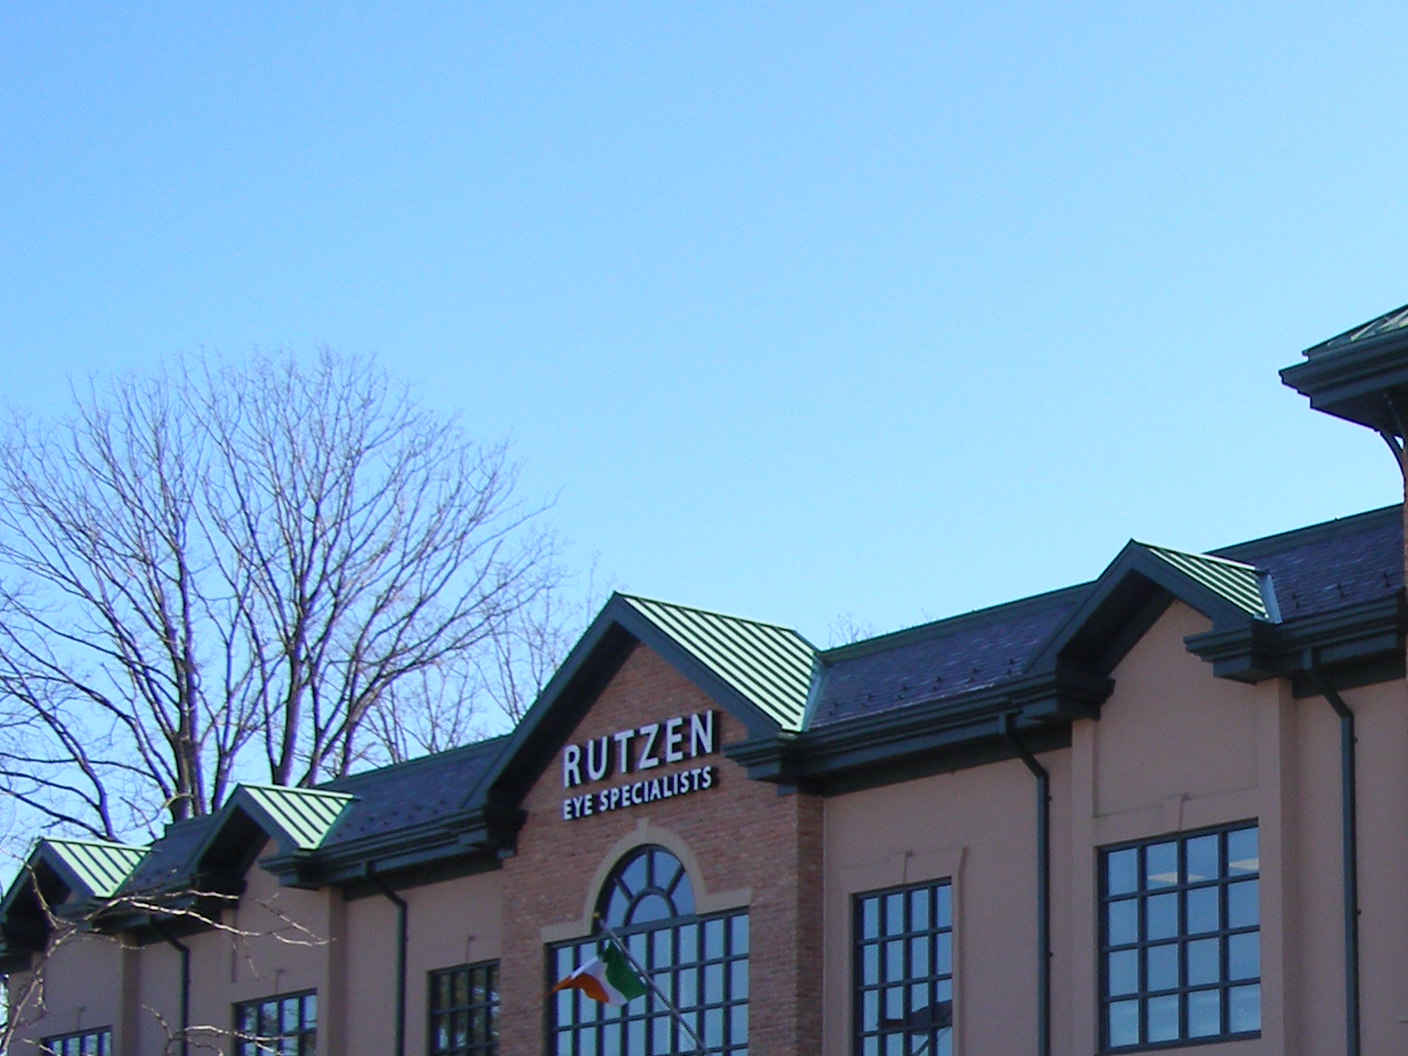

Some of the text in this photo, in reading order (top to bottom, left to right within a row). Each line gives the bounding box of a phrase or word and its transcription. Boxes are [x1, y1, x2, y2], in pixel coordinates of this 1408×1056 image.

[563, 709, 714, 788] RUTZEN
[562, 765, 713, 821] EYE SPECIALISTS
